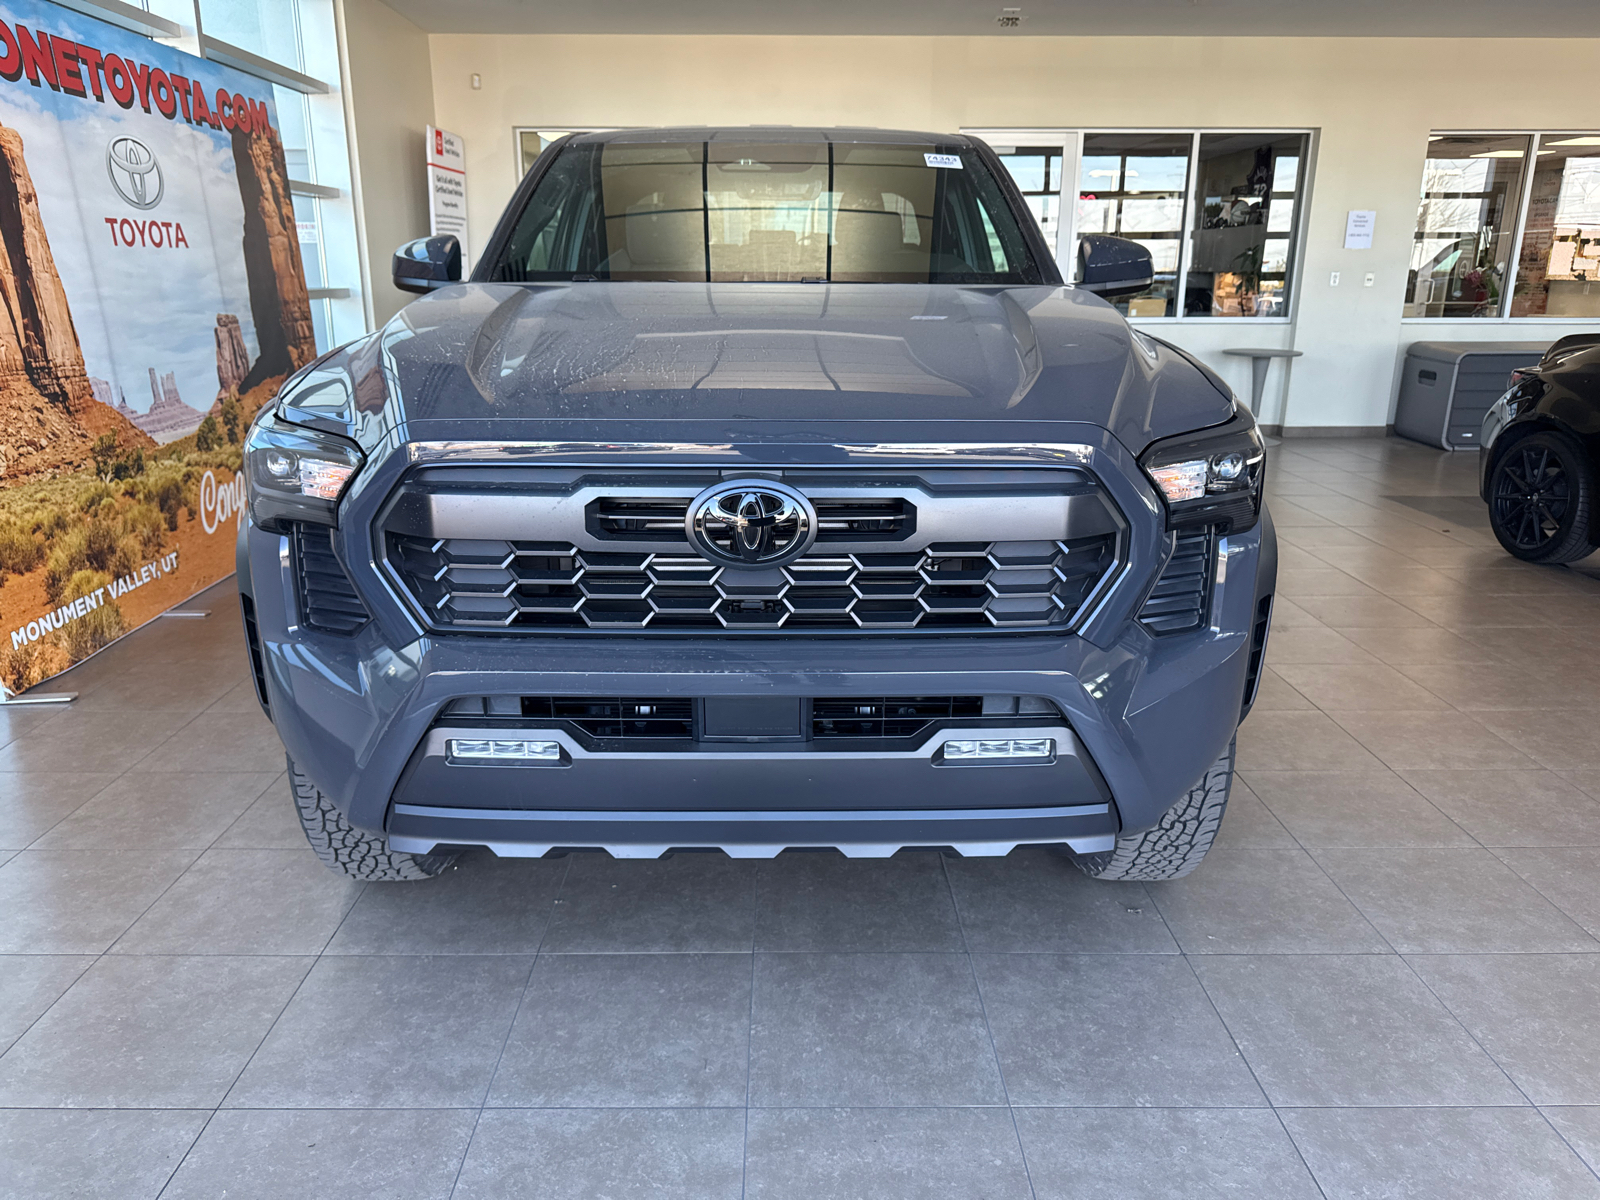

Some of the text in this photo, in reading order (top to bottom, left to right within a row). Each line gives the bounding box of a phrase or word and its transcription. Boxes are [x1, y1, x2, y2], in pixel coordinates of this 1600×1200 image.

[105, 217, 189, 249] TOYOTA
[10, 552, 179, 650] MONUMENT VALLEY, UT
